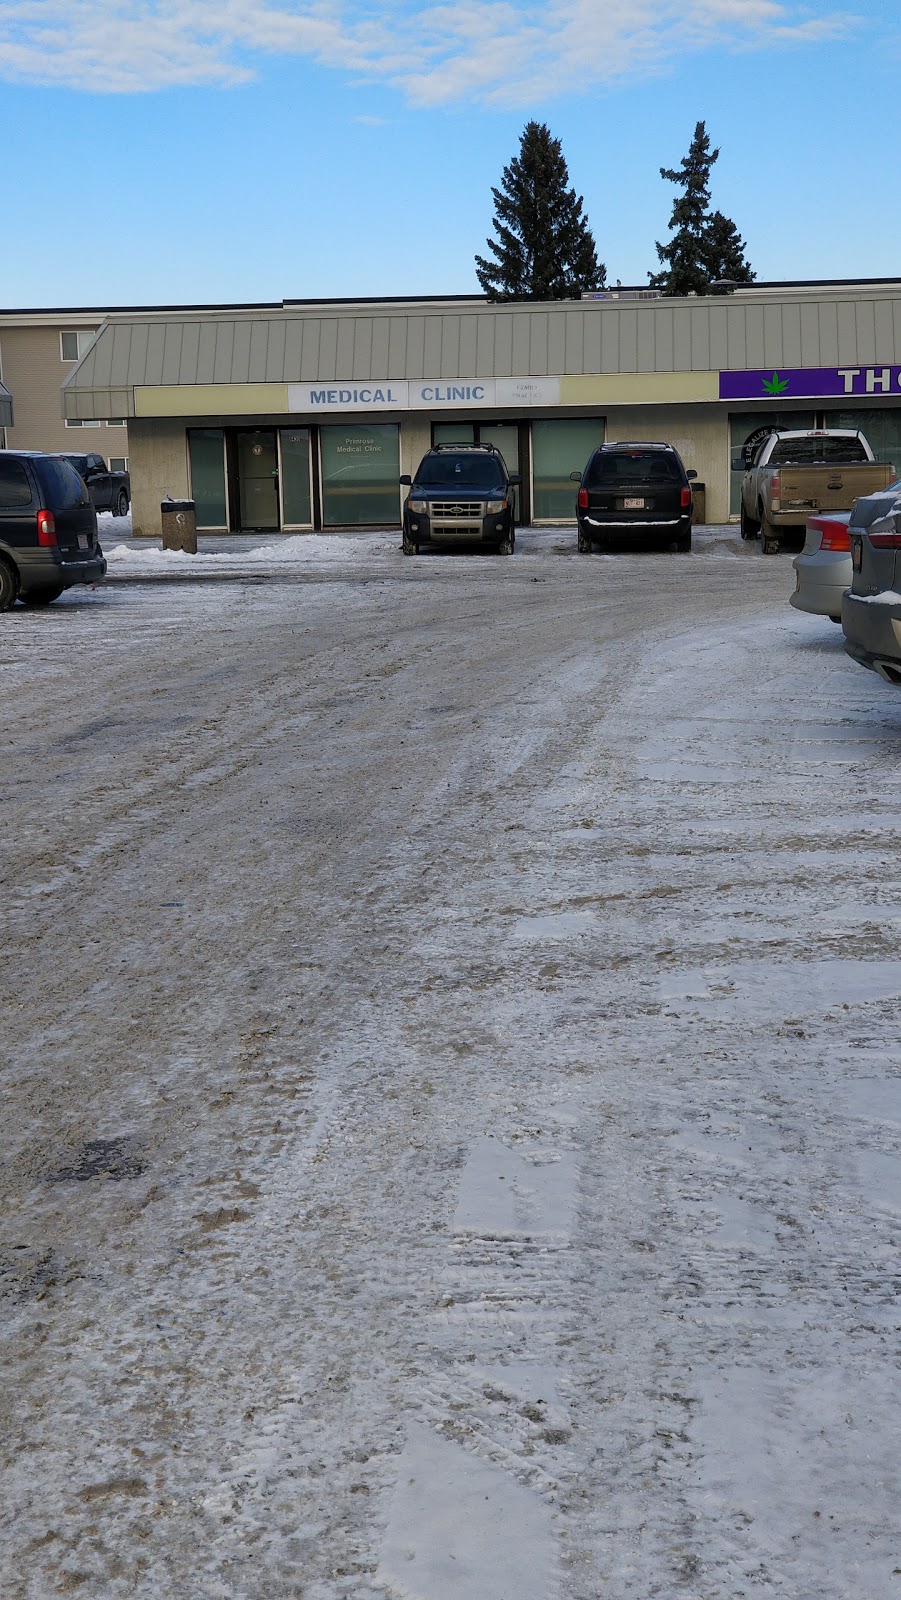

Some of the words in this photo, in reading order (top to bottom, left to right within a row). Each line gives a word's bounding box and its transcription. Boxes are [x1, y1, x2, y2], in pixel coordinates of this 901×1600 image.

[838, 368, 901, 393] TH
[310, 389, 397, 404] MEDICAL
[421, 386, 485, 401] CLINIC
[745, 429, 769, 456] LEGALIZE
